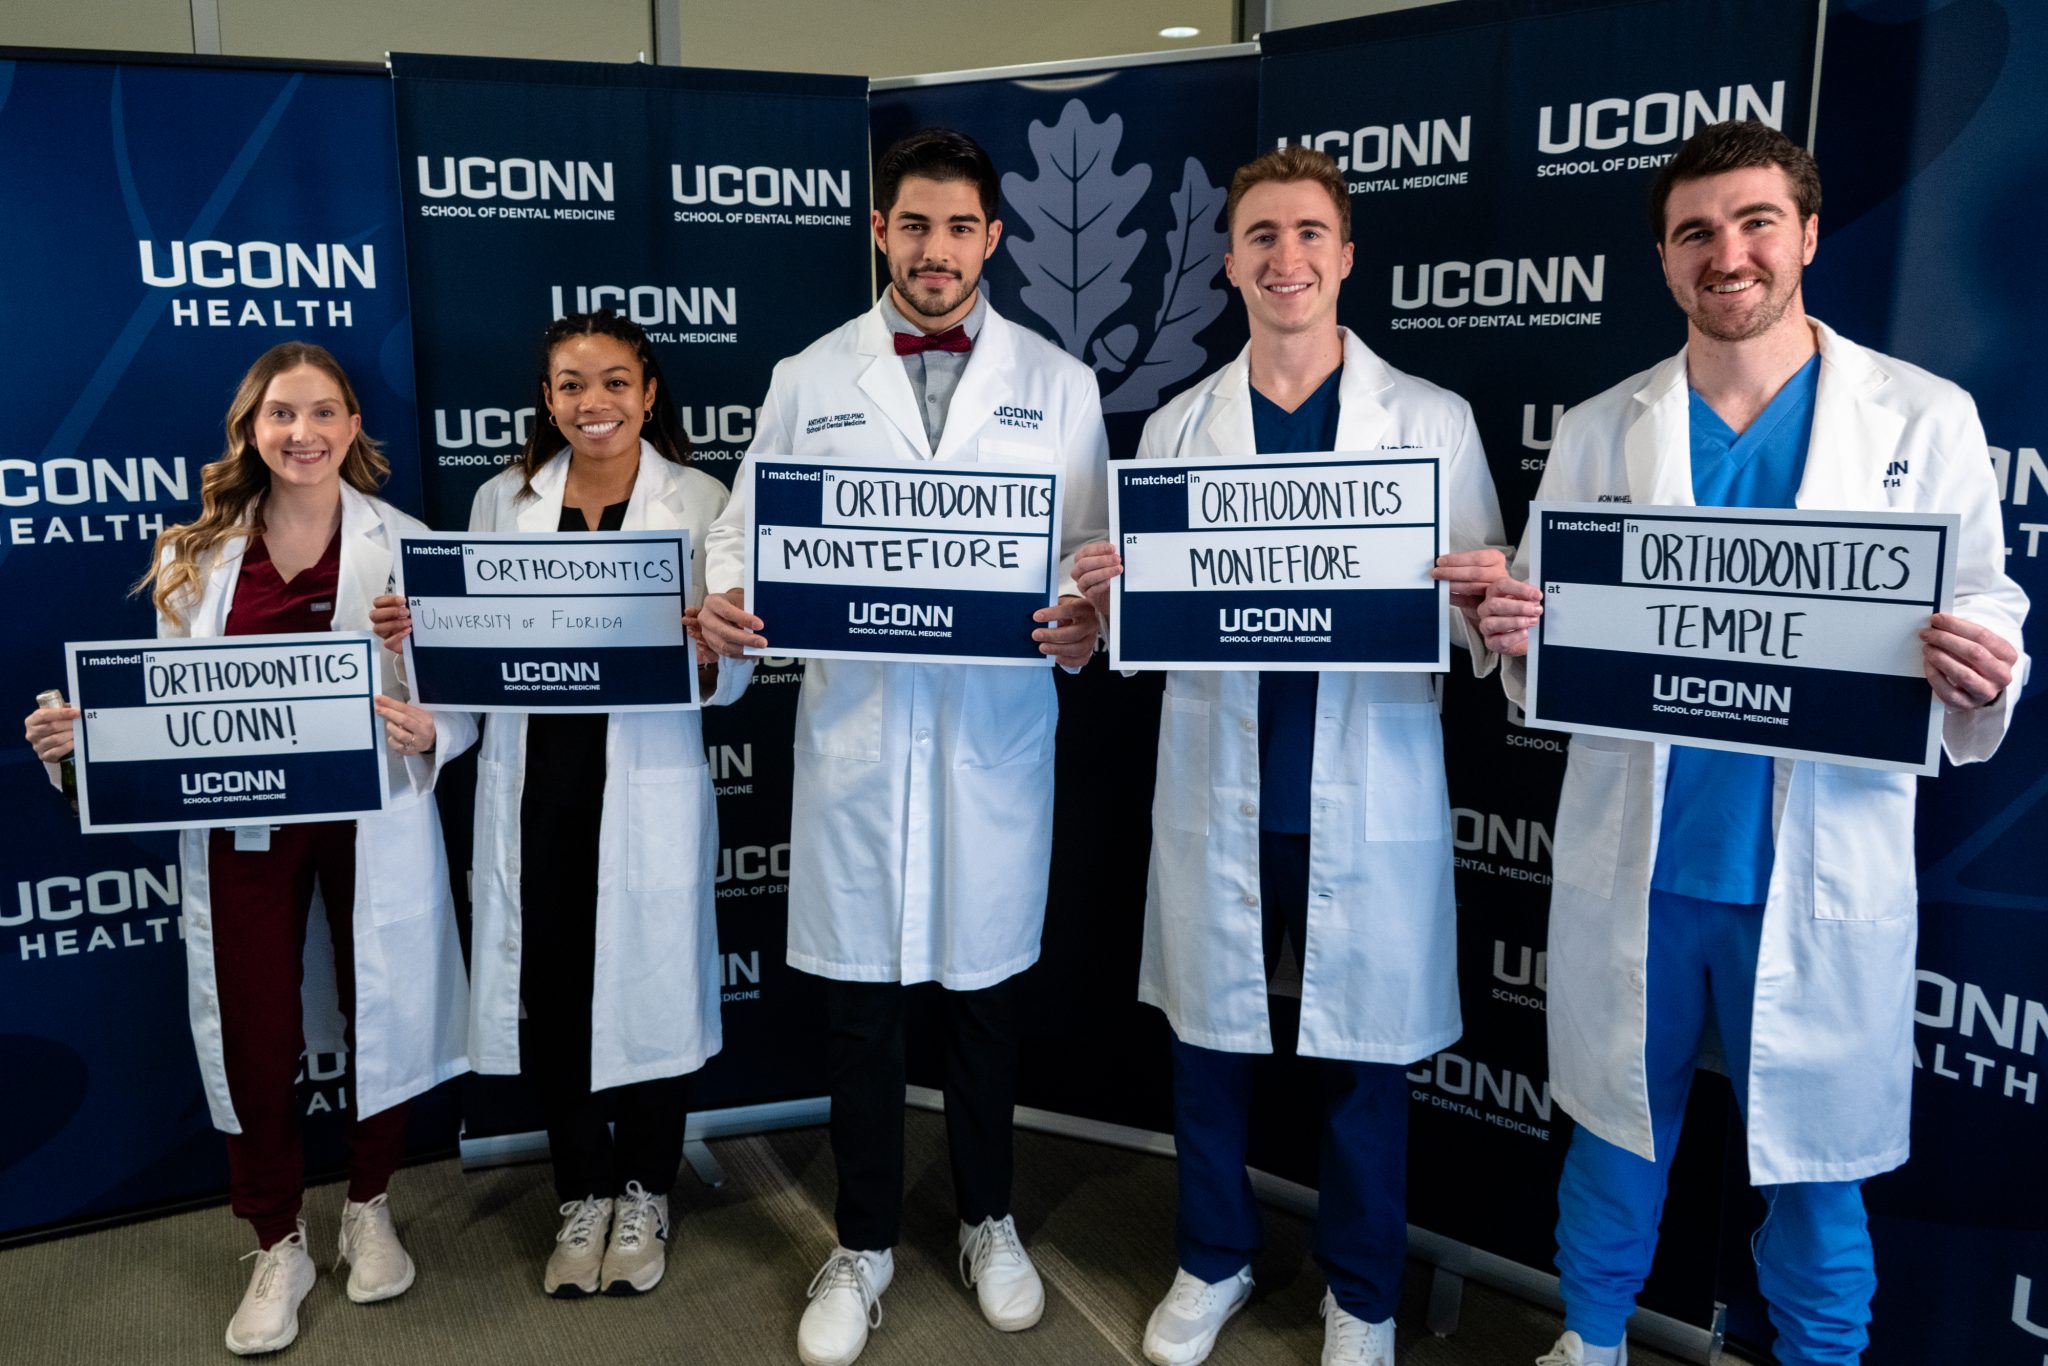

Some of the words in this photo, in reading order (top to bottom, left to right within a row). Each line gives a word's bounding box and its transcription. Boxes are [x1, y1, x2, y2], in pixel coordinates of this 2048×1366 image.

[1538, 80, 1785, 154] UCONN
[1536, 161, 1599, 177] SCHOOL
[1602, 158, 1625, 172] OF
[1627, 153, 1679, 170] DENT
[417, 155, 614, 201] UCONN
[671, 164, 851, 207] UCONN
[1348, 179, 1399, 194] DENTAL
[1402, 172, 1469, 190] MEDICINE
[421, 205, 476, 218] SCHOOL
[478, 207, 496, 218] OF
[500, 207, 551, 219] DENTAL
[554, 209, 615, 220] MEDICINE
[674, 211, 724, 223] SCHOOL
[726, 213, 743, 223] OF
[745, 213, 792, 224] DENTAL
[795, 215, 851, 226] MEDICINE
[139, 240, 376, 289] UCONN
[1391, 254, 1605, 310] UCONN
[172, 299, 352, 327] HEALTH
[1391, 317, 1445, 330] SCHOOL
[1447, 316, 1467, 328] OF
[1469, 314, 1525, 328] DENTAL
[1529, 312, 1602, 326] MEDICINE
[679, 333, 737, 343] MEDICINE
[1000, 417, 1038, 430] HEALTH
[438, 455, 491, 466] SCHOOL
[493, 455, 511, 465] OF
[684, 450, 733, 460] CHOOL
[735, 450, 747, 460] O
[761, 469, 765, 479] I
[768, 470, 821, 482] matched!
[825, 472, 835, 482] in
[1124, 476, 1128, 486] I
[1131, 474, 1185, 486] matched!
[1189, 474, 1200, 484] in
[836, 480, 1052, 519] ORTHODONTICS
[1201, 480, 1402, 523] ORTHODONTICS
[0, 513, 164, 545] EALTH
[761, 527, 772, 536] at
[1548, 519, 1554, 530] I
[1557, 520, 1621, 533] matched!
[1626, 522, 1639, 533] in
[406, 545, 410, 555] I
[412, 545, 461, 555] matched!
[464, 547, 474, 555] in
[1126, 535, 1137, 544] at
[783, 538, 1020, 572] MONTEFIORE
[1189, 544, 1361, 587] MONTEFIORE
[1640, 532, 1910, 591] ORTHODONTICS
[476, 558, 674, 582] ORTHODONTICS
[1547, 584, 1560, 594] at
[411, 598, 421, 607] at
[849, 602, 954, 628] UCONN
[1219, 608, 1332, 632] UCONN
[848, 627, 877, 635] SCHOOL
[918, 630, 952, 638] MEDICINE
[1646, 604, 1807, 659] TEMPLE
[82, 657, 86, 666] I
[89, 655, 141, 665] matched!
[145, 655, 156, 663] in
[149, 653, 358, 698] ORTHODONTICS
[501, 662, 600, 682] UCONN
[1653, 674, 1792, 713] UCONN
[87, 710, 97, 719] at
[1652, 704, 1689, 715] SCHOOL
[1690, 708, 1703, 716] OF
[1704, 709, 1741, 720] DENTAL
[1743, 714, 1789, 726] MEDICINE
[166, 705, 298, 747] UCONN!
[1506, 734, 1563, 753] SCHOOL
[181, 769, 286, 795] UCONN
[750, 885, 766, 895] OF
[721, 990, 760, 1002] DICINE
[1492, 988, 1547, 1011] SCHOOL
[1412, 1090, 1429, 1102] OF
[1431, 1095, 1482, 1120] DENTAL
[1485, 1112, 1550, 1141] MEDICINE
